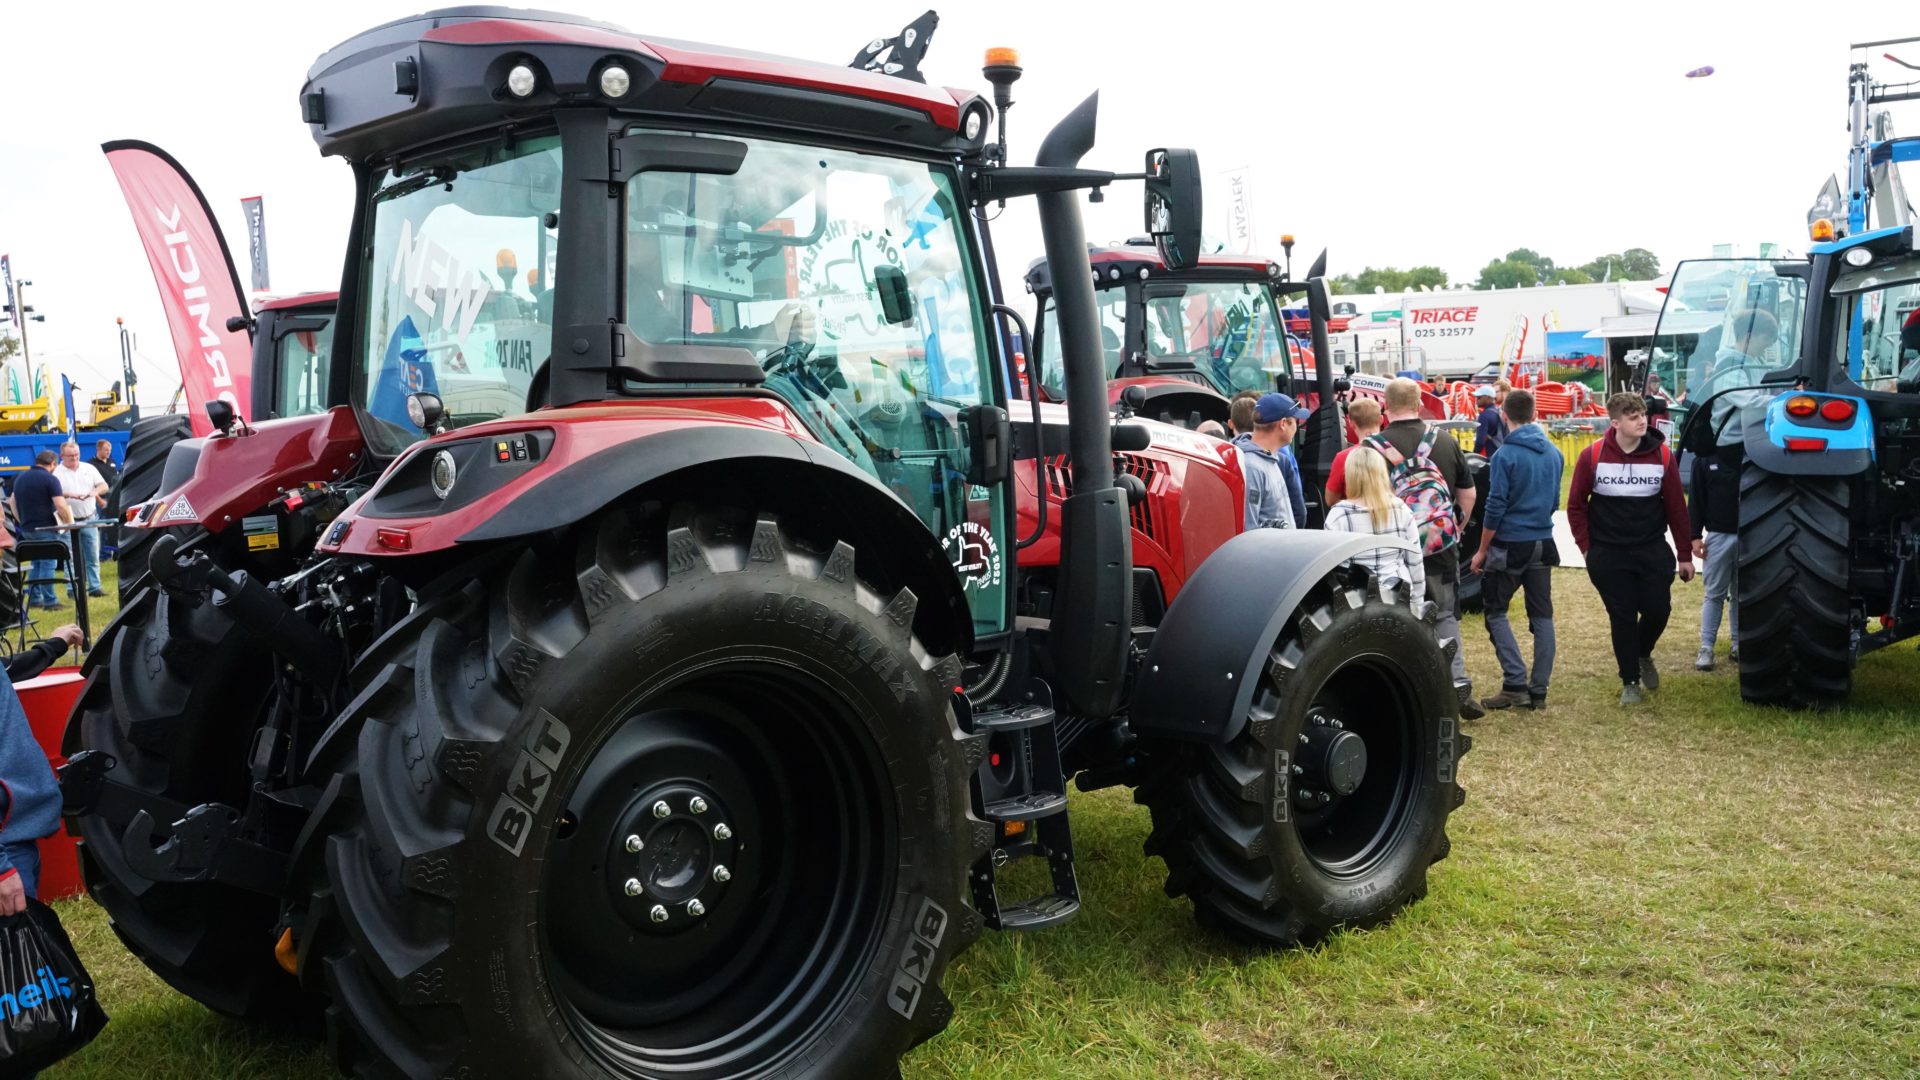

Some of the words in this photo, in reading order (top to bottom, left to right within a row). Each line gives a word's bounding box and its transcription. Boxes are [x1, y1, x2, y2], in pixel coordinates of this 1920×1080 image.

[391, 217, 491, 343] NEW
[1410, 306, 1478, 324] TRIACE
[1414, 329, 1435, 338] 025
[1439, 327, 1474, 337] 32577
[1597, 476, 1660, 485] ACK&JONES
[949, 524, 961, 540] OF
[962, 521, 979, 534] THE
[979, 526, 998, 554] YEAR
[992, 554, 1000, 585] 2023
[487, 707, 571, 857] BKT
[1437, 718, 1455, 783] BKT
[1273, 750, 1290, 822] BKT
[886, 897, 949, 1020] BKT
